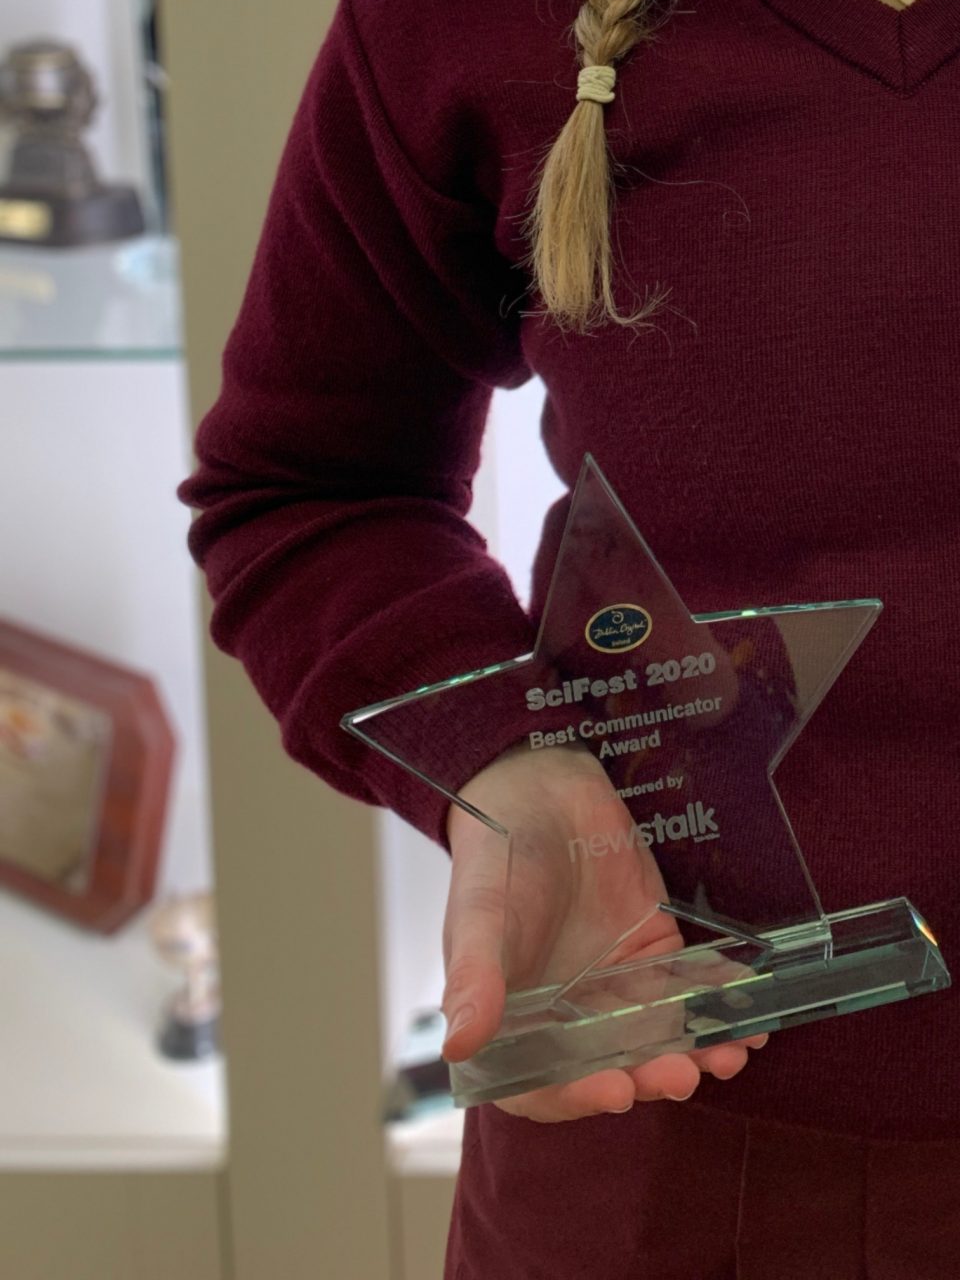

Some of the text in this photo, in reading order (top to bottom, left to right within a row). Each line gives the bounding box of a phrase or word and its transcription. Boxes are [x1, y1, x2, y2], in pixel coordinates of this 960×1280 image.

[525, 652, 716, 711] SciFest 2020
[529, 696, 723, 750] Best Communicator
[599, 730, 662, 759] Award
[666, 775, 684, 791] by
[568, 801, 719, 864] newstalk
